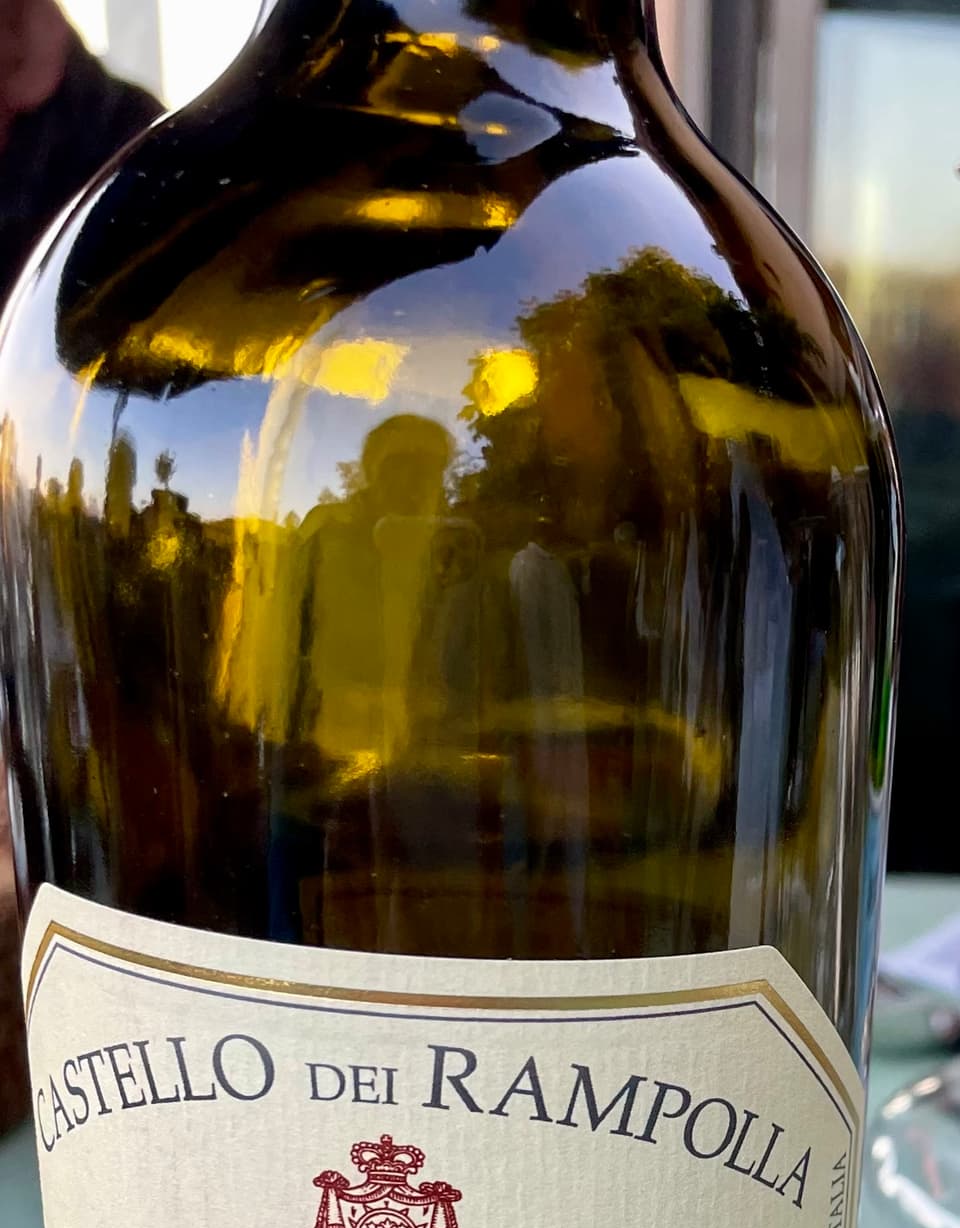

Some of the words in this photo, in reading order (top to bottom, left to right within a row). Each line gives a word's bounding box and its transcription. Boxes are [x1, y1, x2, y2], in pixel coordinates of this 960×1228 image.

[36, 1033, 275, 1153] CASTELLO
[309, 1062, 399, 1105] DEI
[422, 1044, 813, 1210] RAMPOLLA
